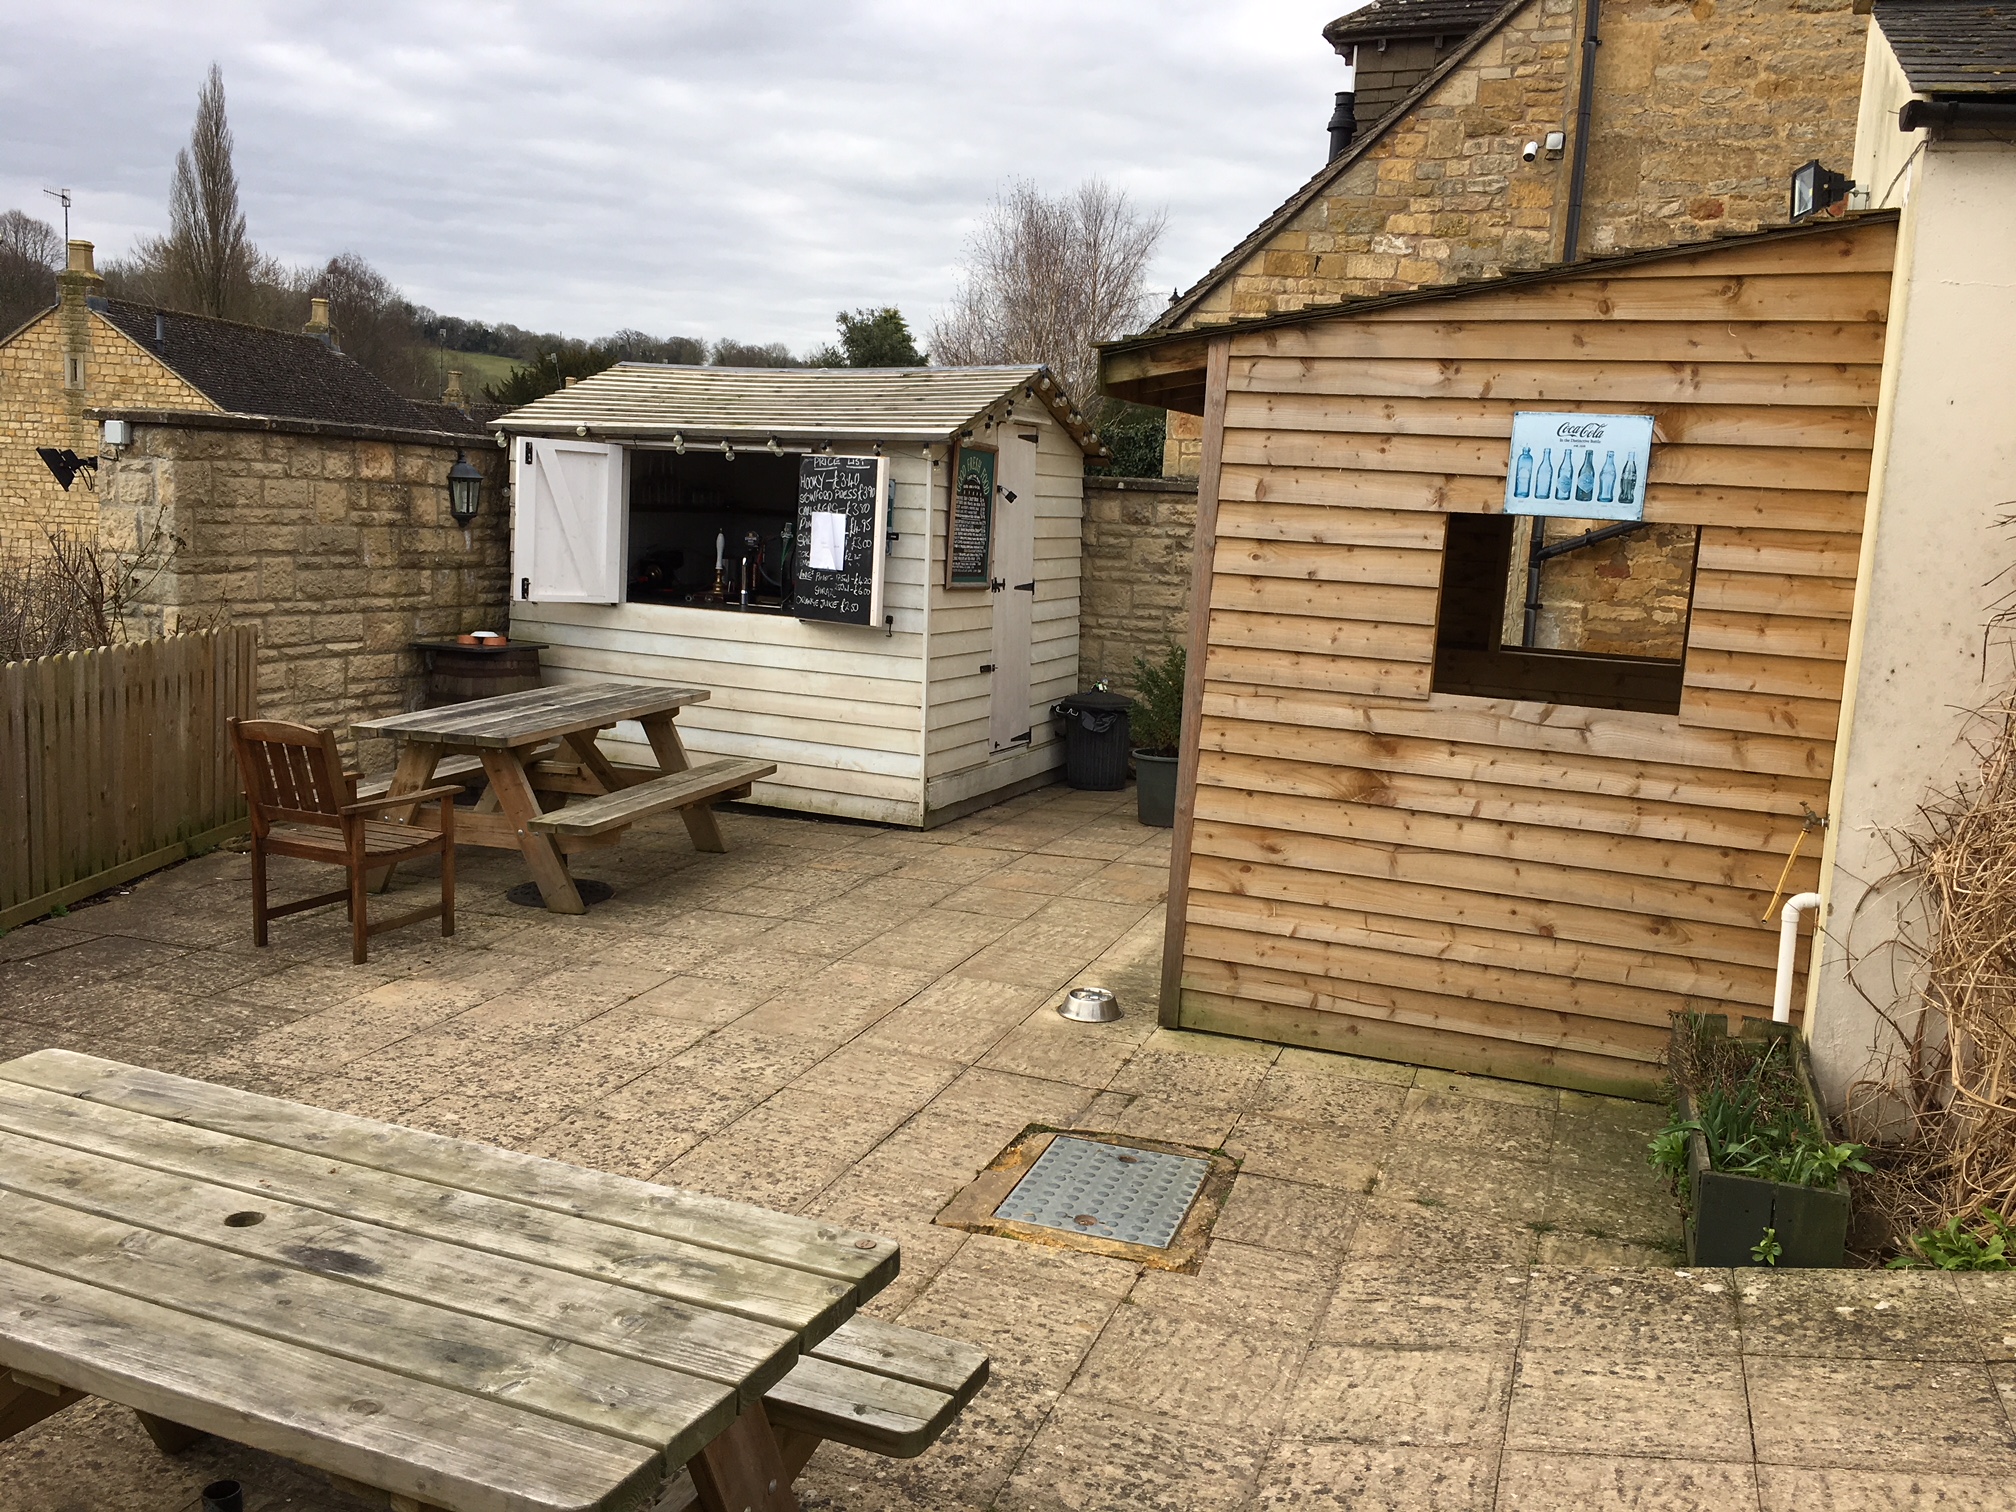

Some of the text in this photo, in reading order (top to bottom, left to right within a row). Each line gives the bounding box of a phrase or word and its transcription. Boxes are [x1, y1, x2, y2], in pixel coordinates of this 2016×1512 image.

[813, 456, 866, 468] PRICE LIST
[980, 467, 990, 495] FOOD
[834, 488, 858, 500] PRESS
[819, 599, 839, 609] JUICE
